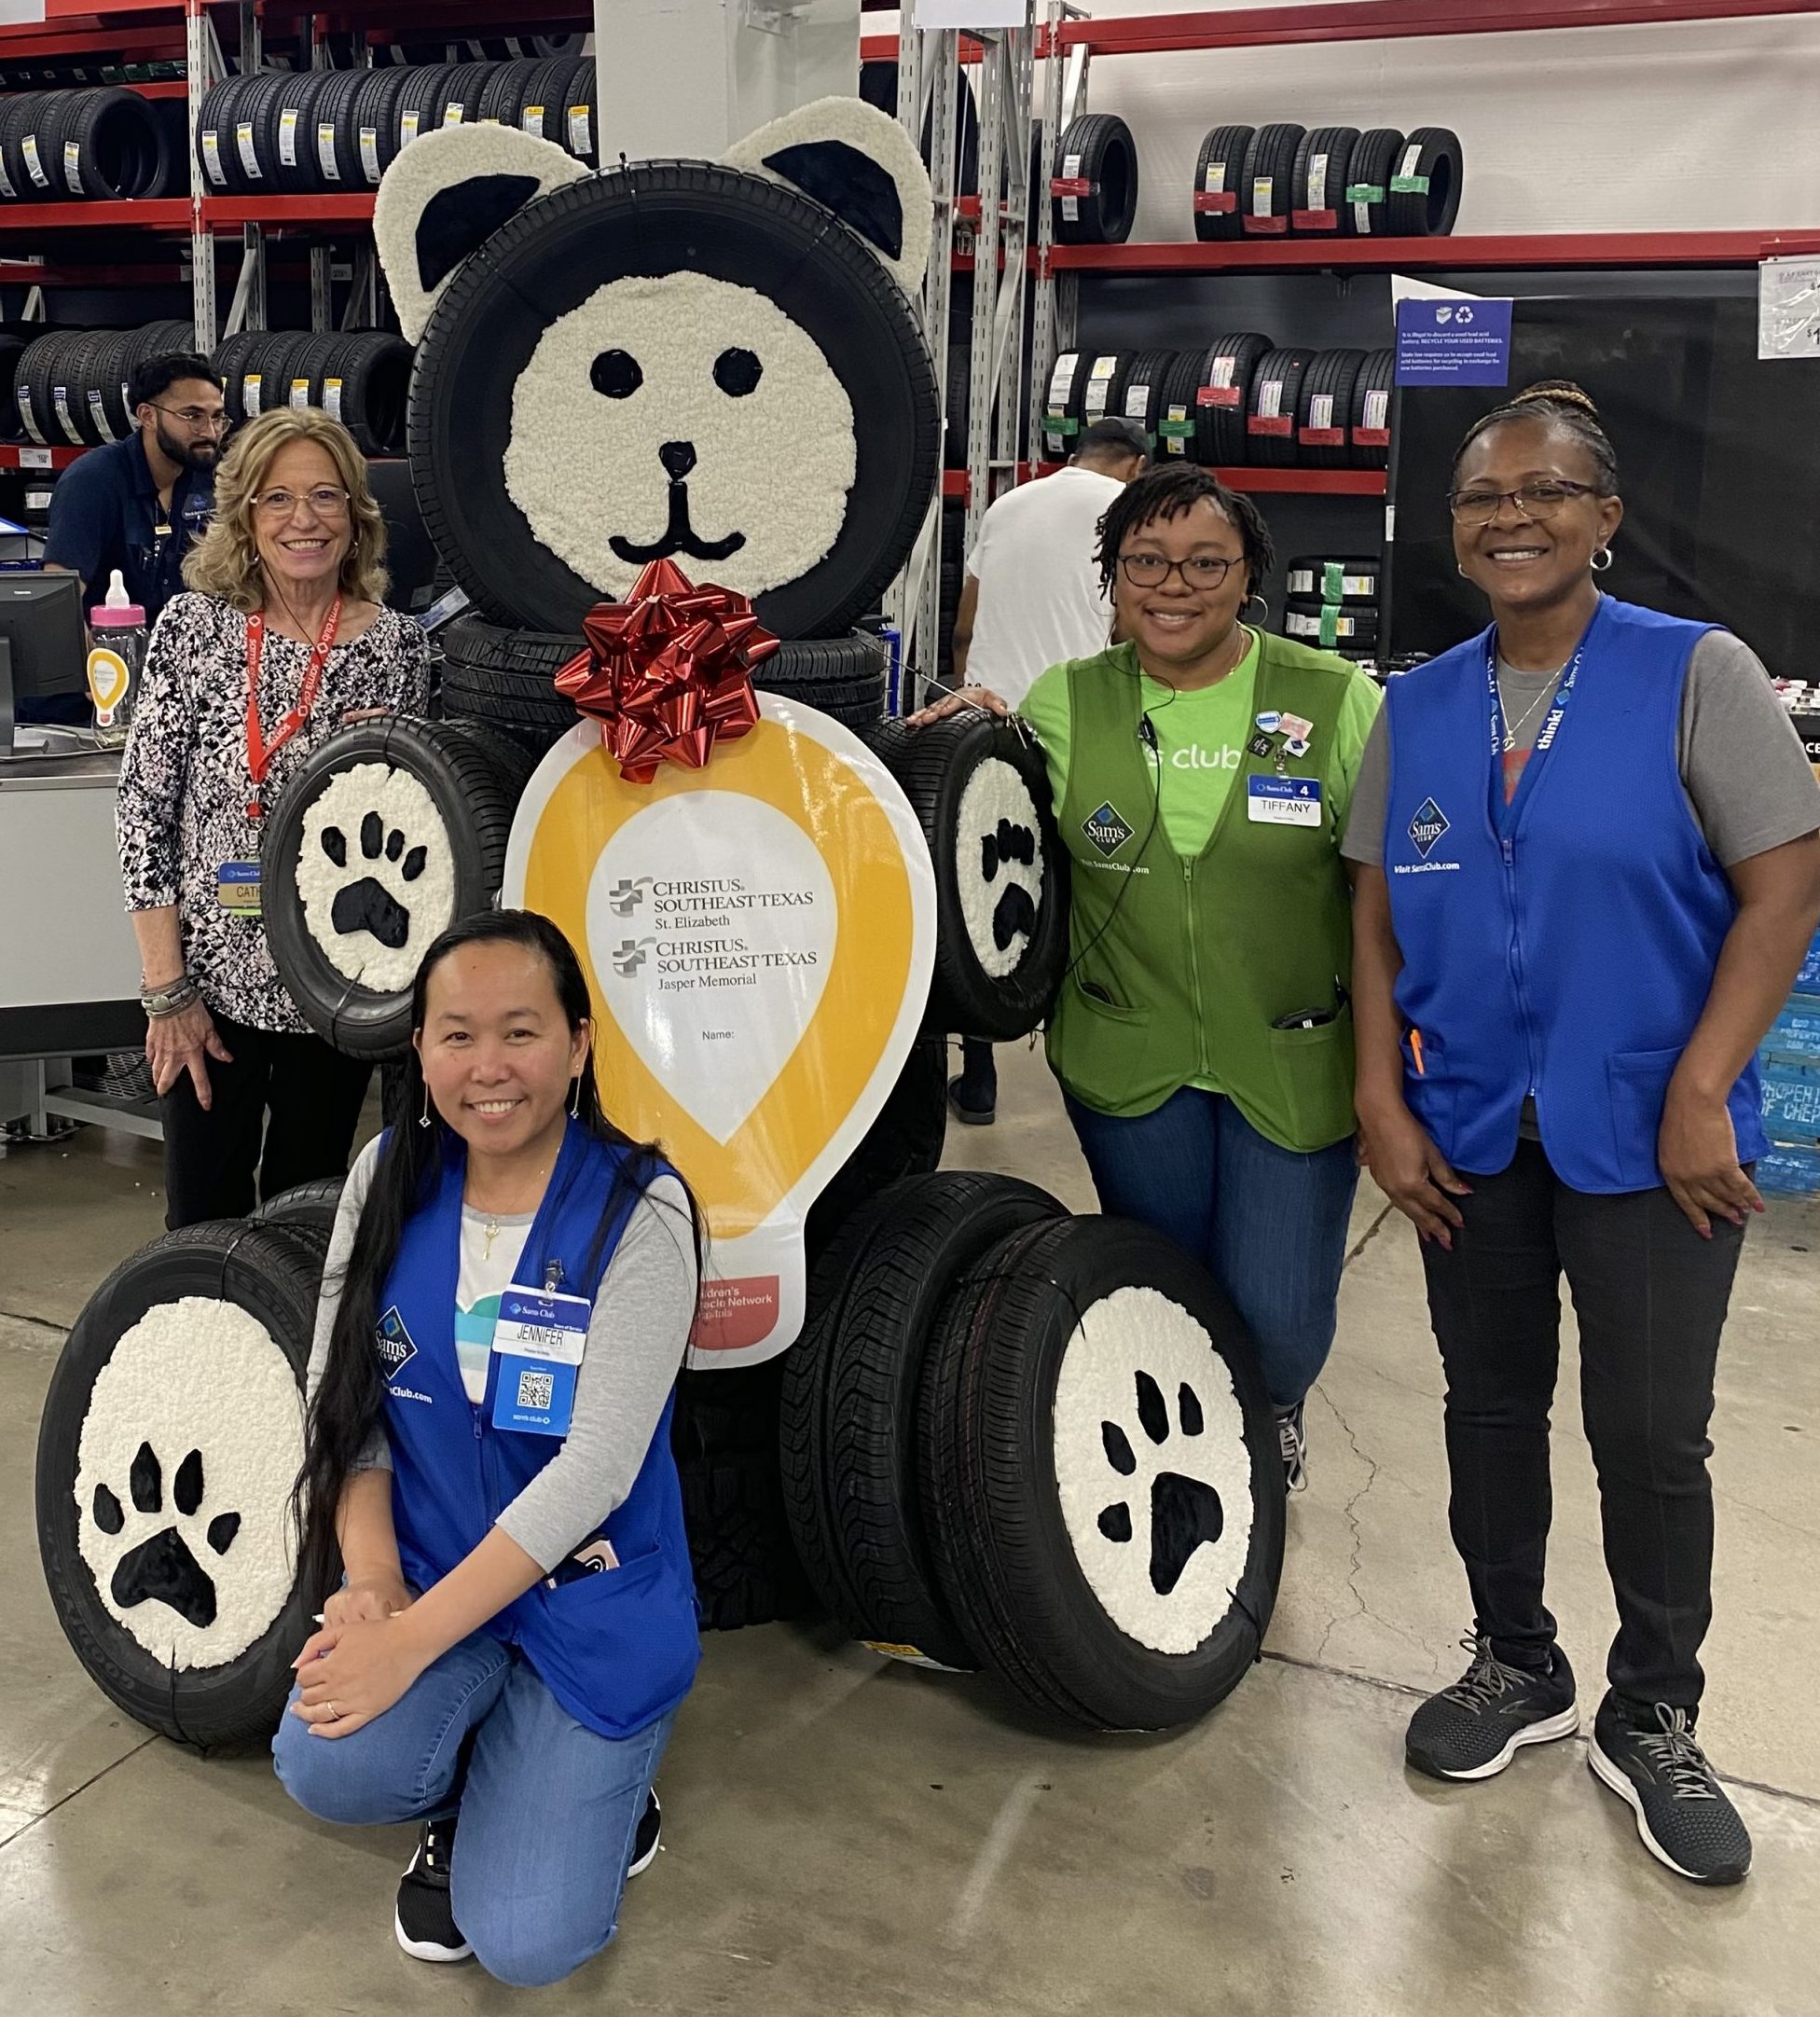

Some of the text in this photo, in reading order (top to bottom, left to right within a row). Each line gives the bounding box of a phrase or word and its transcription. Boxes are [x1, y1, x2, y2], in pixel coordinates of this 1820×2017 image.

[1171, 743, 1242, 769] club
[1300, 785, 1309, 796] 4
[1261, 799, 1311, 813] TIFFANY
[1087, 821, 1125, 839] Sam's
[1413, 822, 1441, 838] Sam's
[1096, 836, 1117, 844] CLUB
[1094, 861, 1150, 874] SamsClubom
[655, 891, 814, 913] SOUTHEAST TEXAS
[655, 915, 730, 930] St. Elizabeth
[657, 951, 817, 974] SOUTHEAST TEXAS
[658, 974, 756, 992] Jasper Memorial
[702, 1030, 735, 1041] Name:
[728, 1294, 772, 1306] Network
[540, 1309, 555, 1319] Club
[517, 1324, 564, 1346] JENNIFER
[376, 1330, 407, 1358] Sam's
